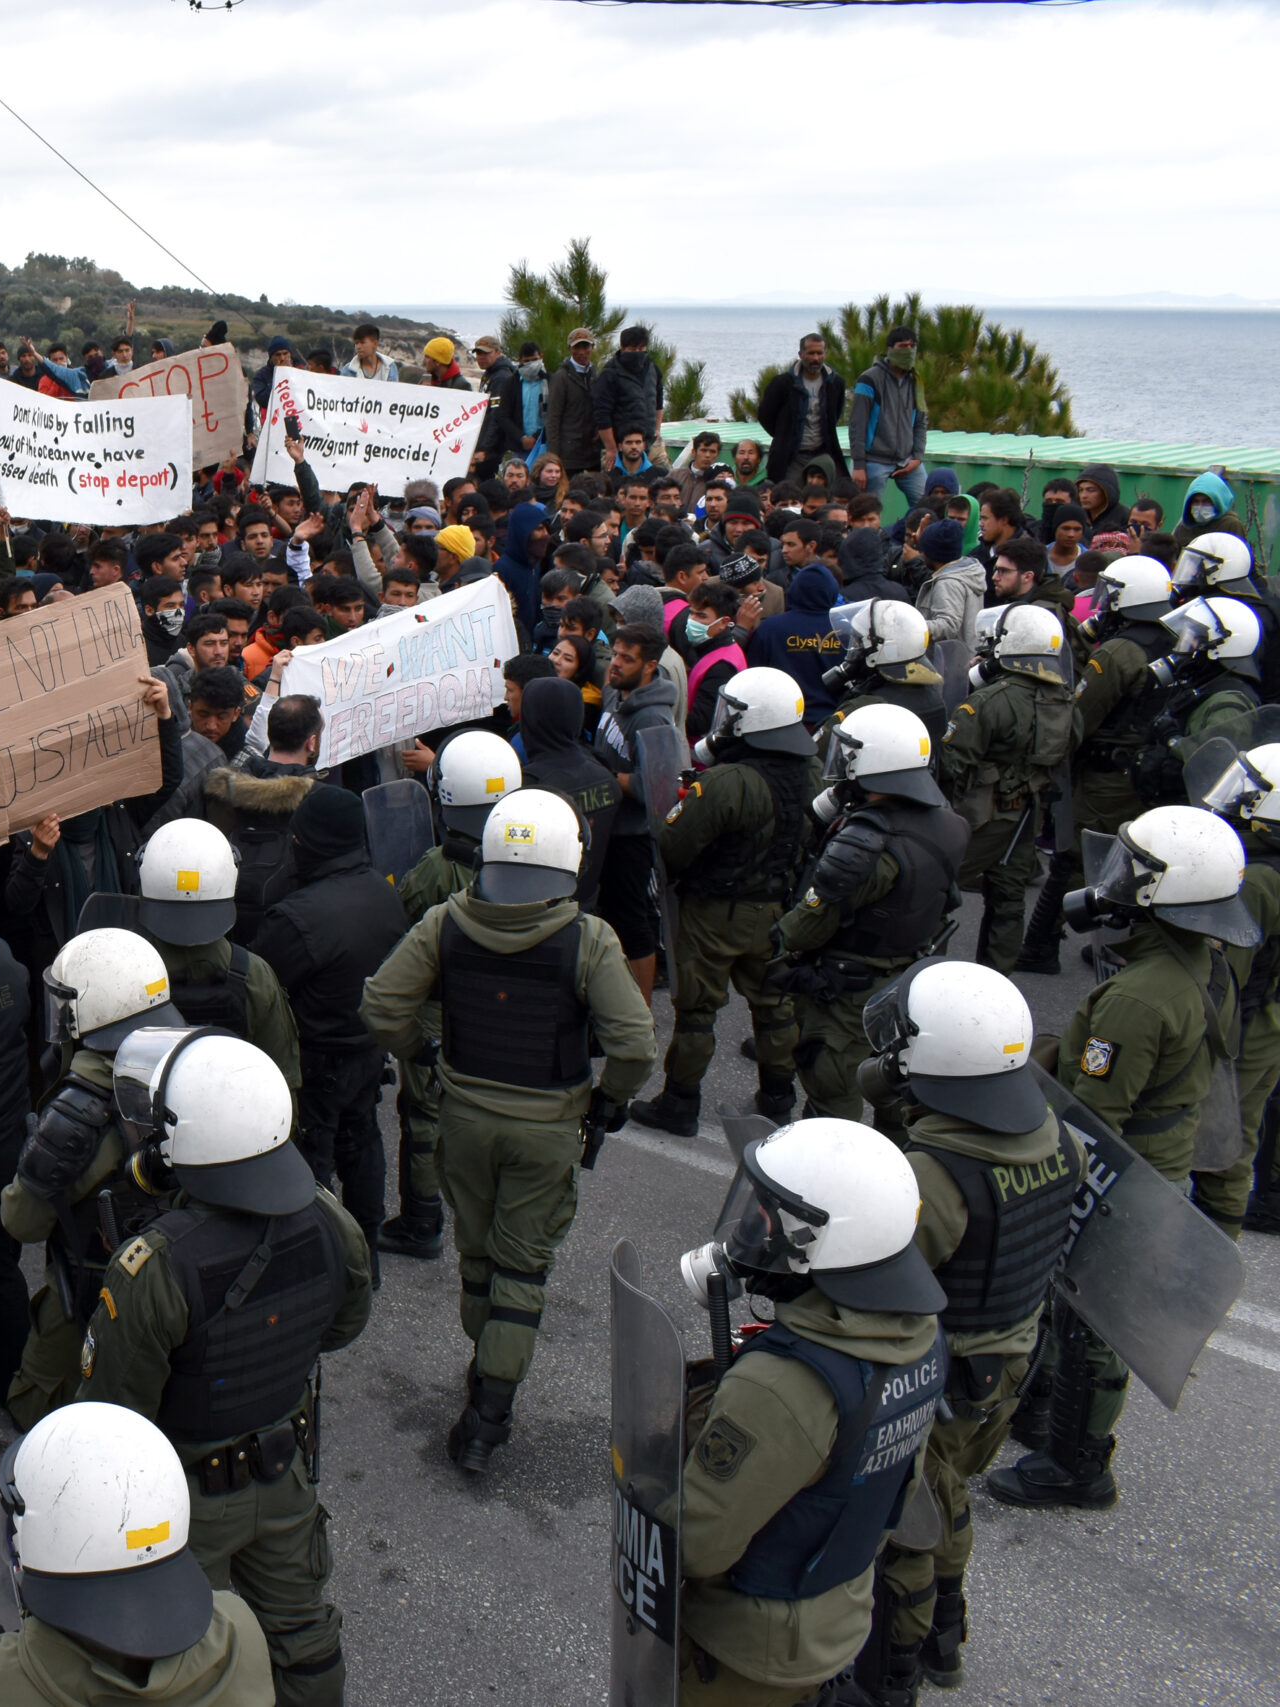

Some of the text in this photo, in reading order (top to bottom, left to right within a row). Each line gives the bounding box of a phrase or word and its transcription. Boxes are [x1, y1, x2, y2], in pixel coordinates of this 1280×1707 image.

[56, 413, 69, 437] by
[73, 410, 135, 438] falling
[307, 388, 440, 422] Deportation equals
[16, 436, 26, 453] of
[38, 445, 70, 462] ocean
[70, 450, 96, 463] we
[103, 447, 145, 463] have
[302, 433, 438, 475] mmigrant genocide!
[0, 462, 178, 497] ssed death (stop deport)
[5, 618, 67, 702] NOT
[320, 604, 497, 707] WE WANT
[83, 697, 160, 769] ALIVE
[328, 666, 494, 768] FREEDOM
[992, 1146, 1069, 1203] POLICE
[880, 1357, 939, 1406] POLICE
